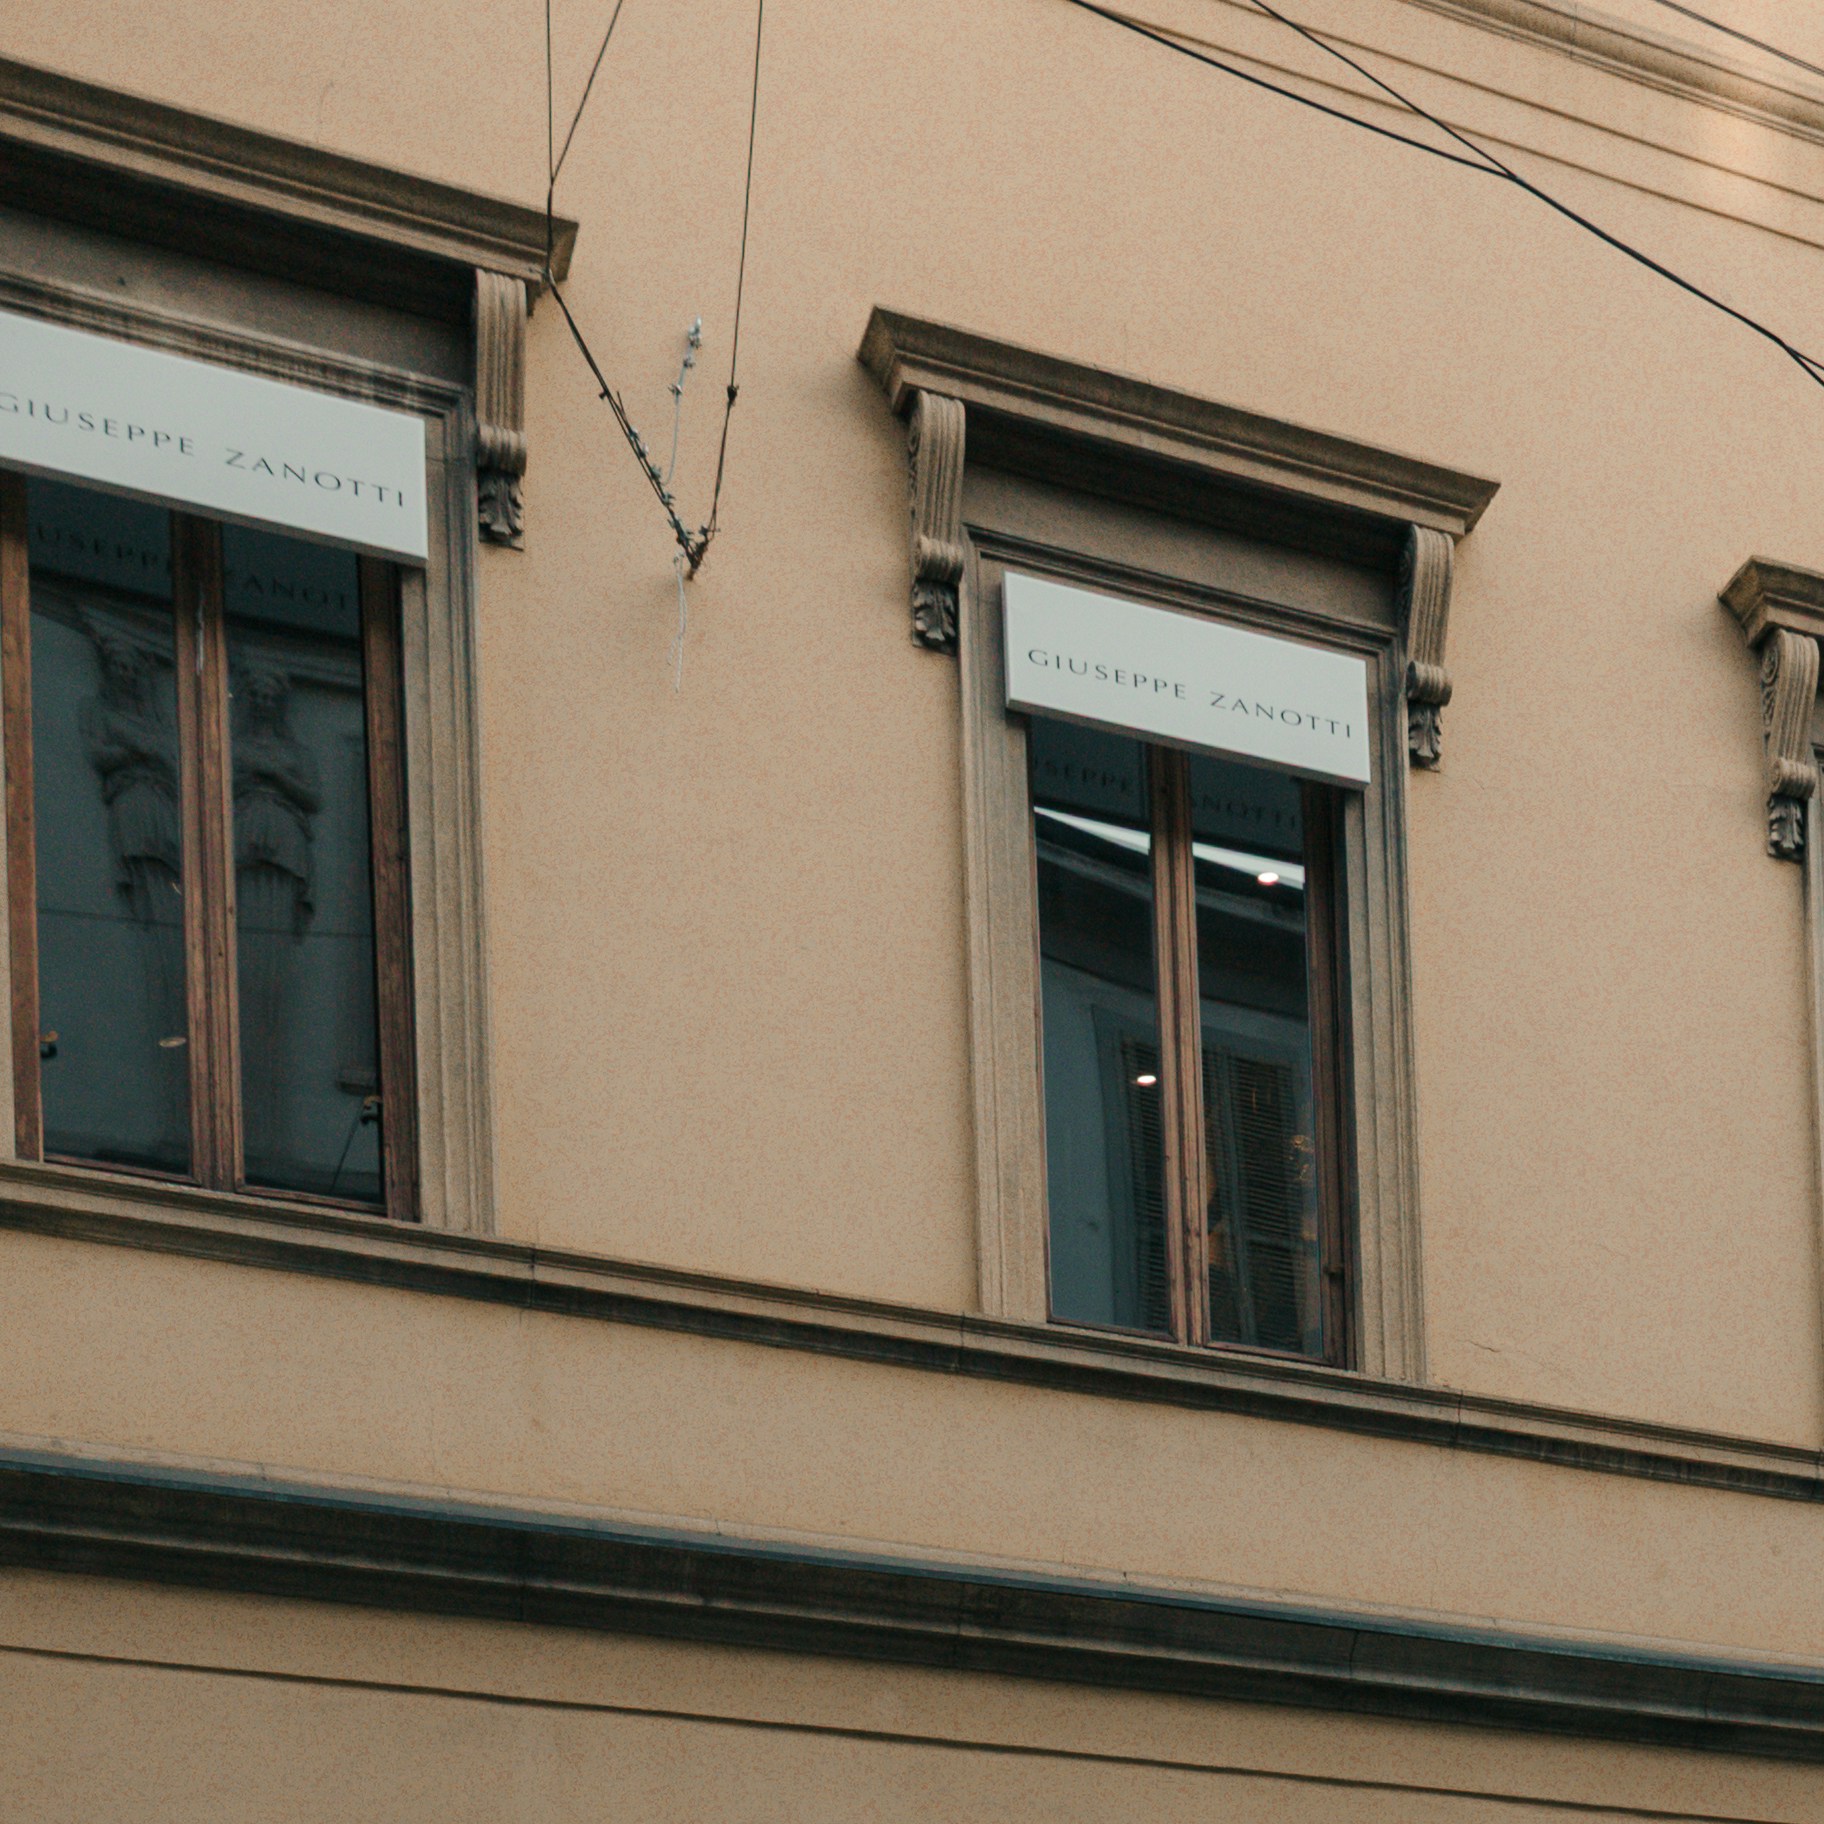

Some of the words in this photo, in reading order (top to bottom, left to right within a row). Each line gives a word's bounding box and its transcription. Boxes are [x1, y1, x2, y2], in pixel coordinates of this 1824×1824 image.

[0, 392, 195, 456] GIUSEPPE
[225, 447, 404, 507] ZANOTTI
[1028, 648, 1186, 701] GIUSEPPE
[1210, 691, 1351, 739] ZANOTTI
